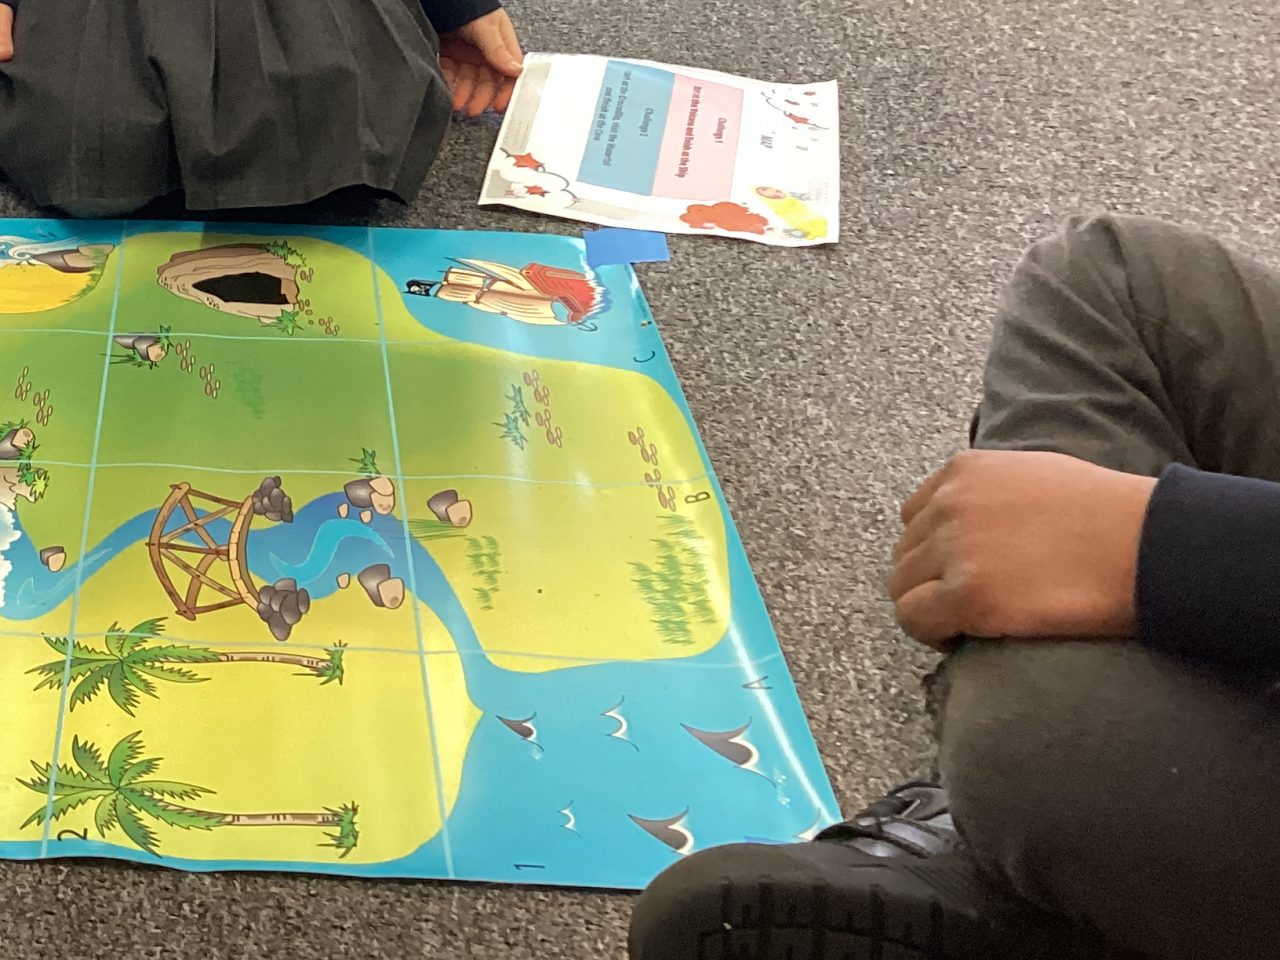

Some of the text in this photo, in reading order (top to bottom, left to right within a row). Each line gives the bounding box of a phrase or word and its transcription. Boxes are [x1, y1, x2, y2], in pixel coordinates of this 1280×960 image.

[604, 86, 612, 97] and
[620, 86, 628, 94] the
[600, 97, 613, 113] finish
[691, 98, 700, 108] the
[638, 108, 654, 133] Challenge
[686, 108, 698, 126] Volcano
[596, 120, 607, 129] the
[713, 117, 727, 139] Challenge
[608, 133, 618, 142] the
[685, 127, 694, 136] and
[682, 136, 694, 150] finish
[678, 157, 690, 166] the
[674, 166, 688, 178] Ship
[684, 490, 711, 505] B
[742, 675, 774, 690] A
[57, 827, 88, 841] 2
